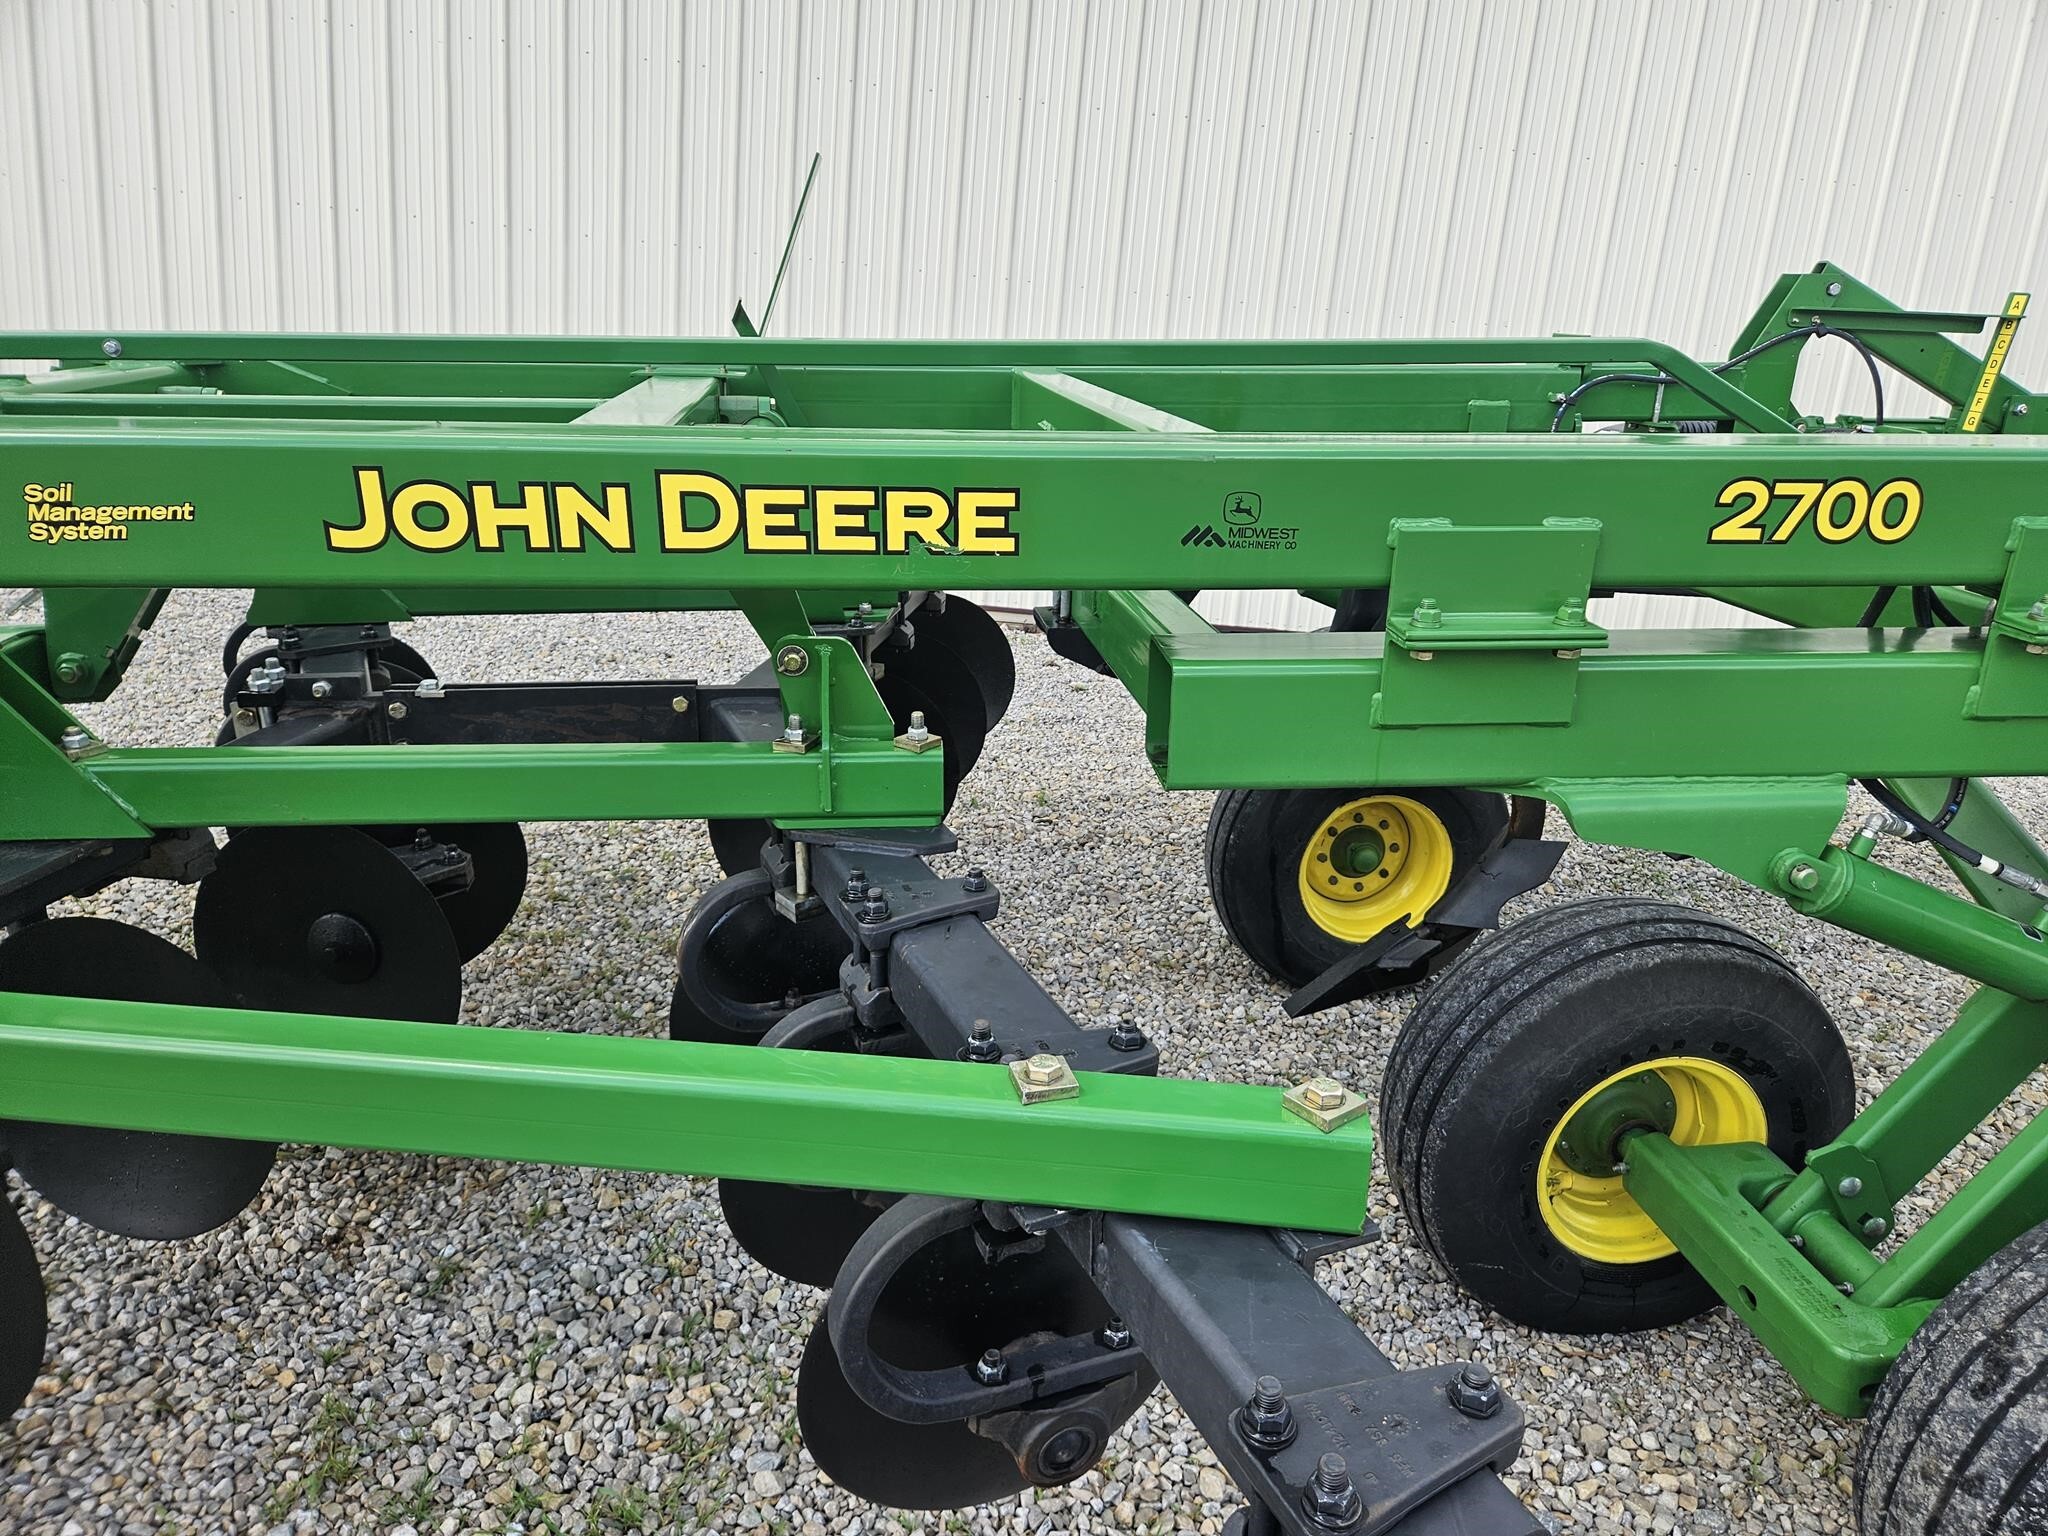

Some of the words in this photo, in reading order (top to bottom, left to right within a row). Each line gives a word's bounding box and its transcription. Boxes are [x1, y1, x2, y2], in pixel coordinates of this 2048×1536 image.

[2012, 301, 2020, 310] A
[2005, 320, 2013, 330] B
[1997, 340, 2006, 349] C
[1990, 359, 1998, 368] D
[1982, 379, 1990, 388] E
[1975, 398, 1983, 407] F
[1967, 416, 1976, 426] G
[23, 482, 73, 503] Soil
[27, 501, 195, 525] Management
[324, 465, 635, 554] JOHN
[654, 469, 1020, 556] DEERE
[1707, 476, 1924, 545] 2700
[28, 522, 129, 545] System
[1228, 527, 1299, 540] MIDWEST
[1228, 540, 1281, 550] MACHINERY
[1284, 541, 1297, 550] CO
